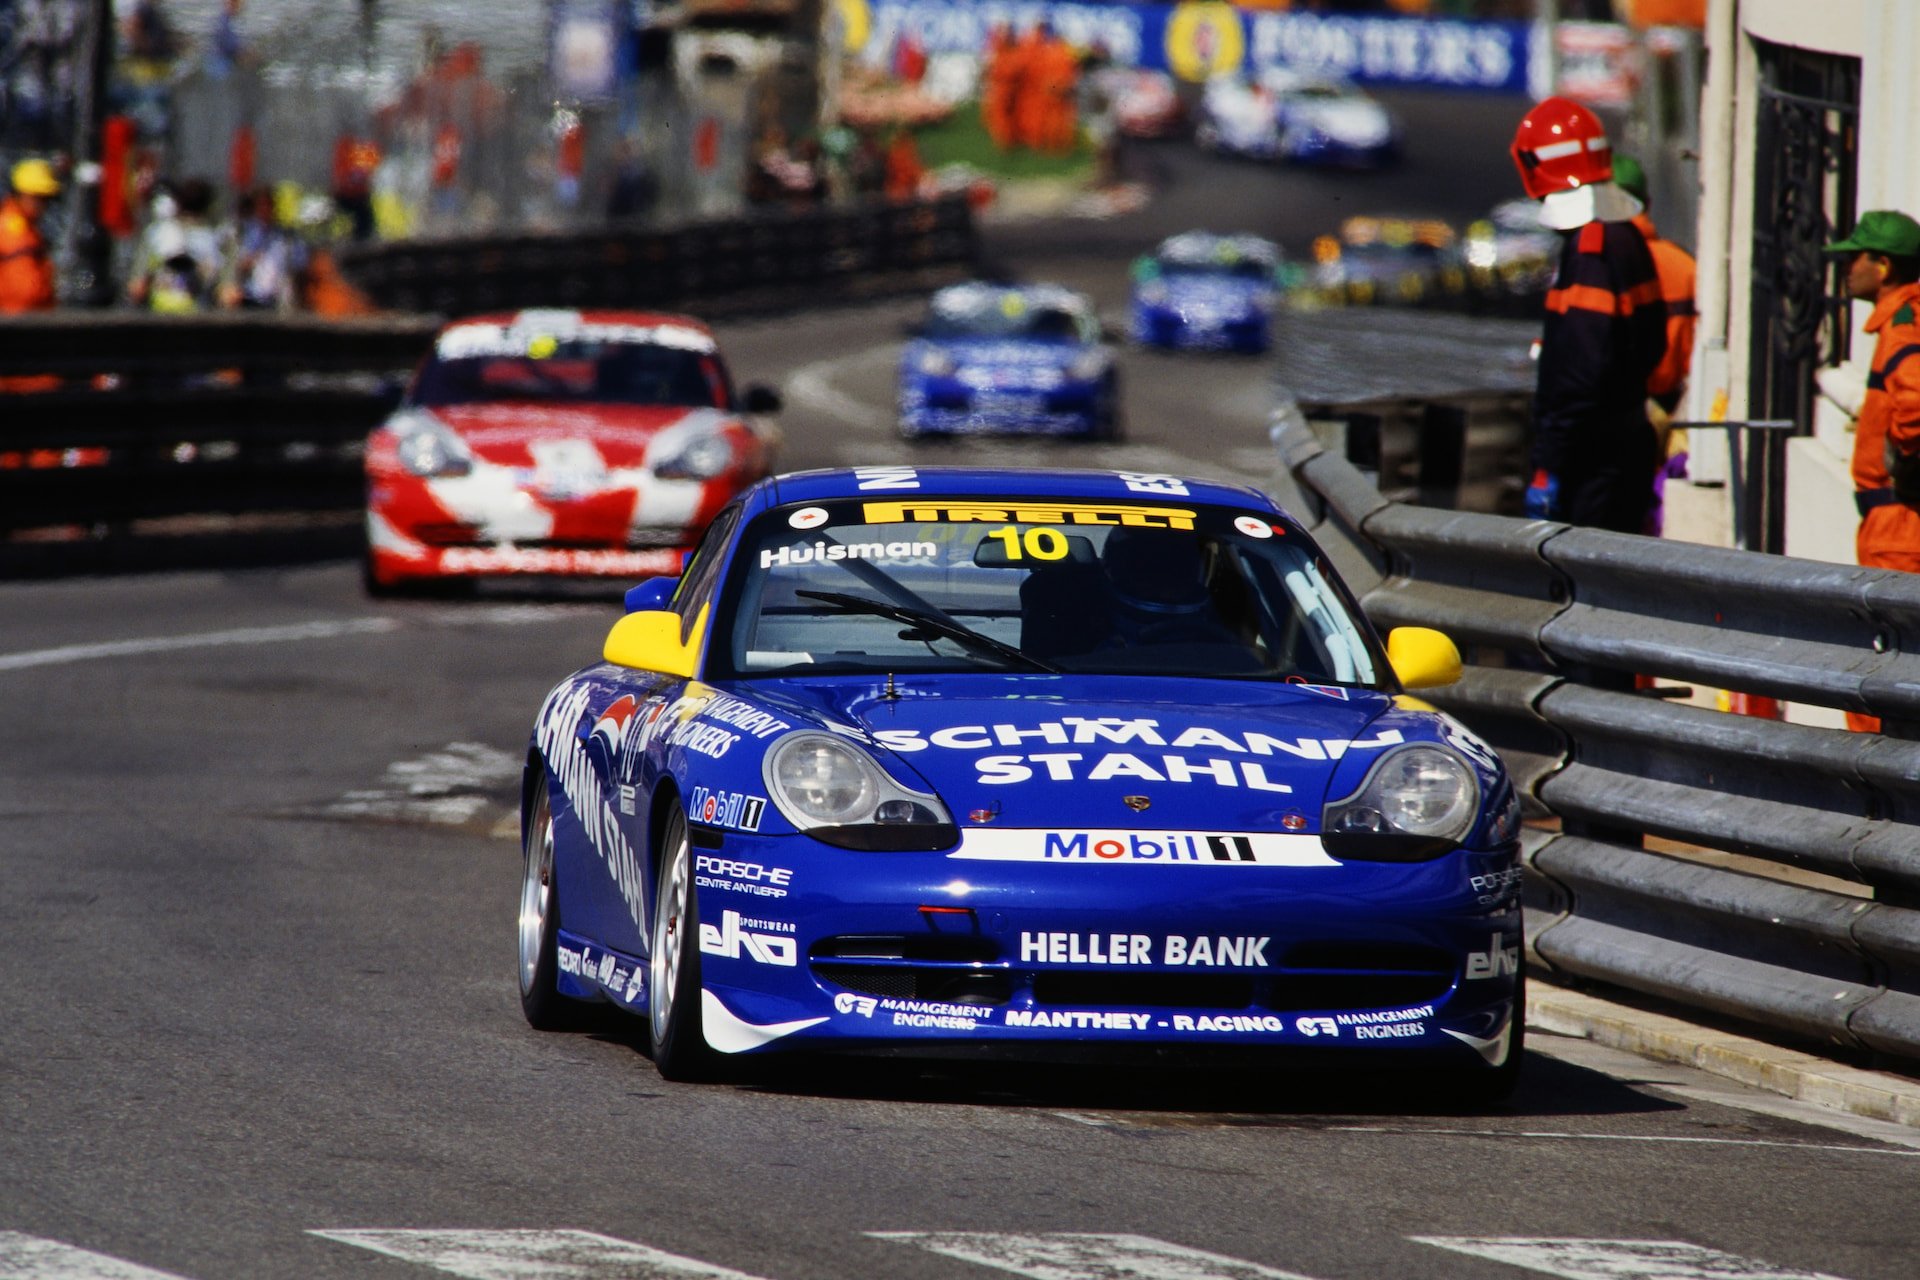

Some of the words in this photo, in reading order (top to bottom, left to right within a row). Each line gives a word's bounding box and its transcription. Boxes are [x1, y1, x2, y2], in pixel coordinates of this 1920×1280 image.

[863, 501, 1197, 530] PIRELLI
[760, 541, 937, 569] Huisman
[988, 525, 1069, 560] 10
[974, 752, 1293, 794] STAHL
[689, 786, 743, 828] Mobil
[1044, 833, 1199, 860] Mobil
[695, 855, 793, 886] PORSCHE
[695, 876, 732, 891] CENTRE
[732, 882, 788, 898] ANTWERP
[739, 917, 796, 933] SPORTSWEAR
[1020, 931, 1152, 965] HELLER
[1164, 935, 1271, 966] BANK
[880, 998, 994, 1018] MANAGEMENT
[893, 1012, 977, 1030] ENGINEERS
[1004, 1010, 1151, 1030] MANTHEY
[1172, 1014, 1283, 1032] RACING
[1336, 1005, 1435, 1025] MANAGEMENT
[1355, 1021, 1426, 1039] ENGINEERS
